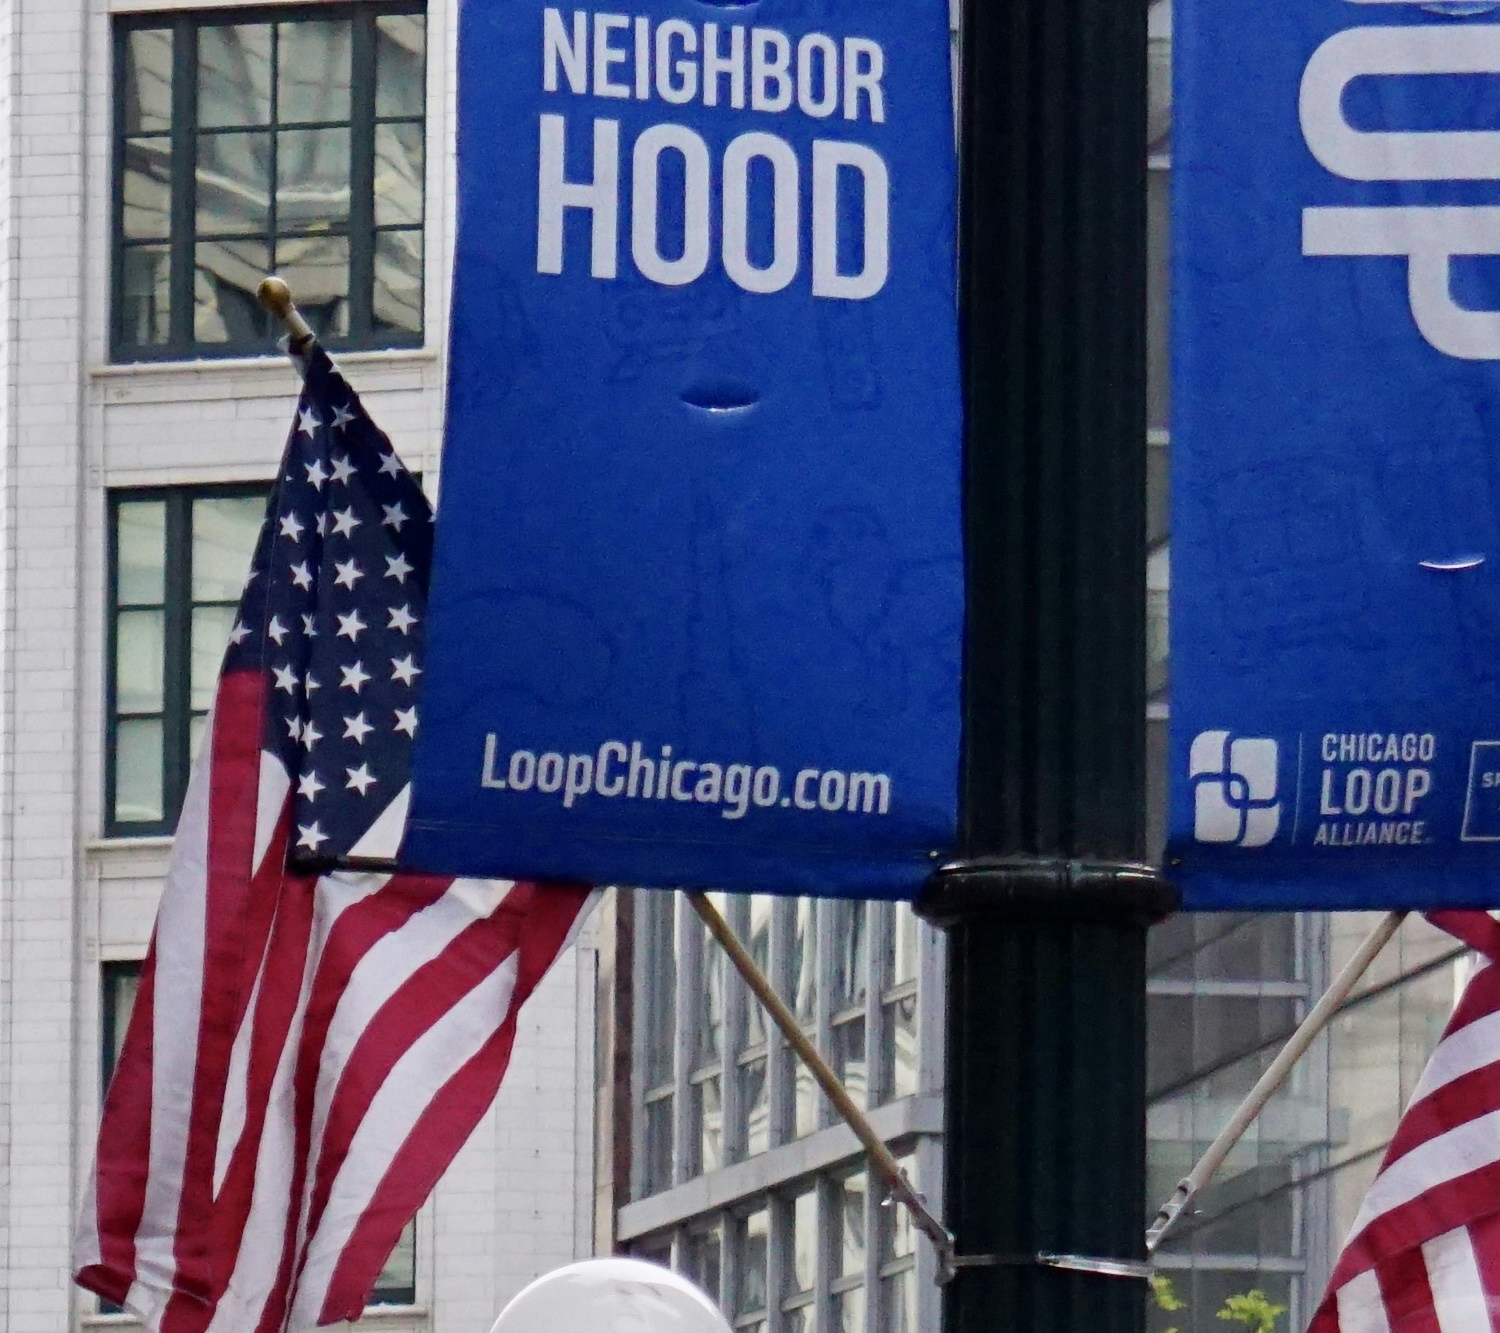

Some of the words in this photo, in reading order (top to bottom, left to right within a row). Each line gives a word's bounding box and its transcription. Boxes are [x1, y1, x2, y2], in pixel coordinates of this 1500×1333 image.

[543, 7, 886, 123] NEIGHBOR
[537, 114, 889, 300] HOOD
[480, 732, 891, 820] LoopChicago.com
[1321, 732, 1435, 764] CHICAGO
[1319, 768, 1431, 817] LOOP
